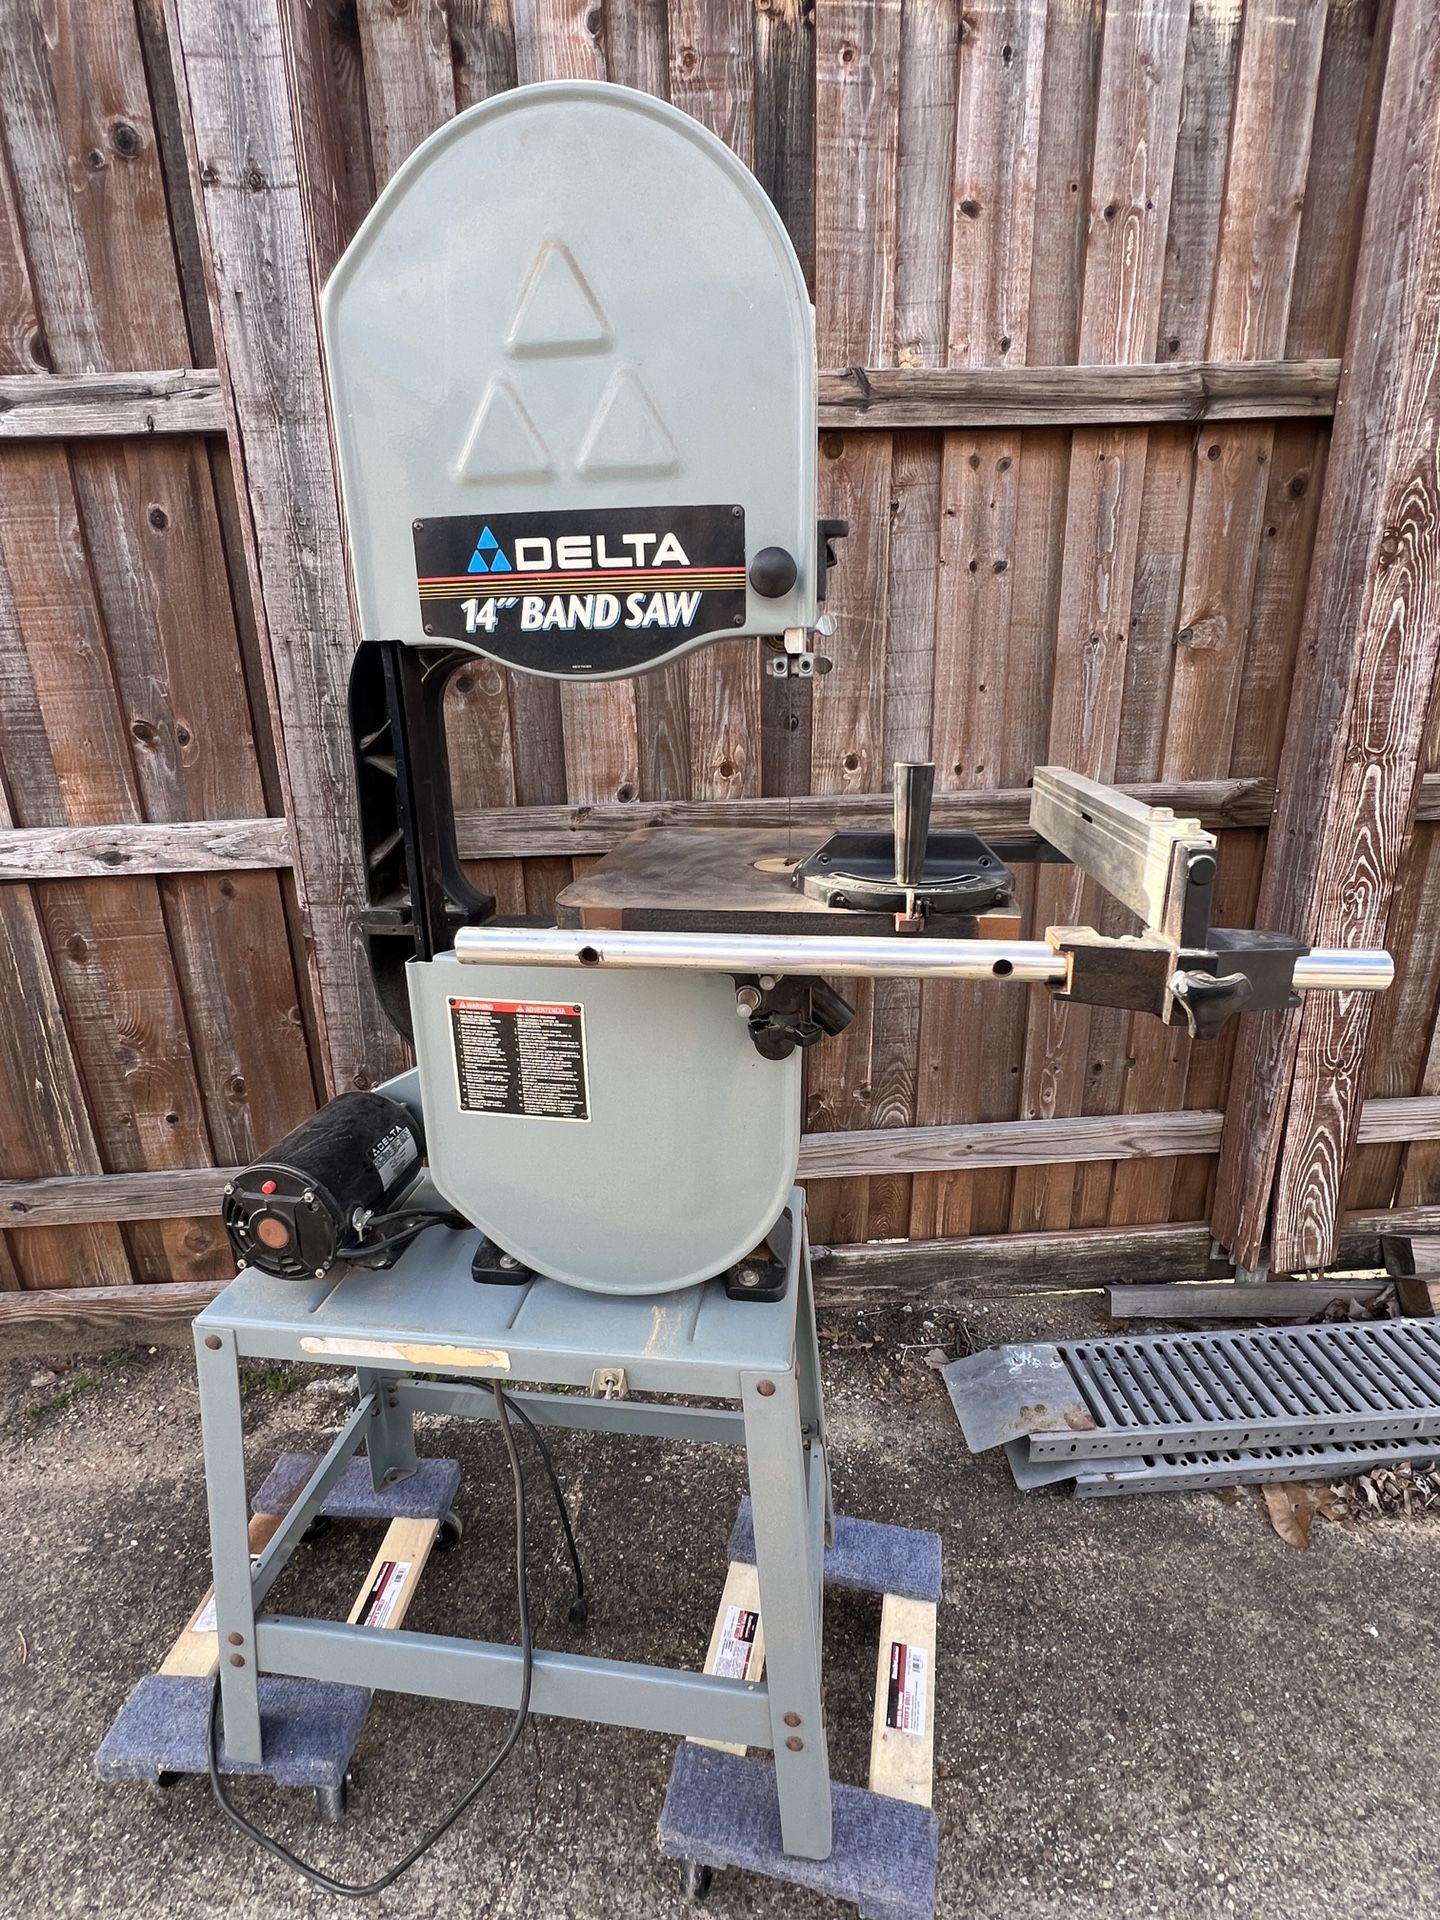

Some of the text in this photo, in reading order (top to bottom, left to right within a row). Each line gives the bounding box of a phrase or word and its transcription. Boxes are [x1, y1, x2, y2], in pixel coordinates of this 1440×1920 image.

[515, 532, 691, 571] DELTA
[460, 591, 703, 634] 14" BAND SAW
[525, 1006, 565, 1014] ADVERTENCIA
[378, 1125, 402, 1152] DELTA
